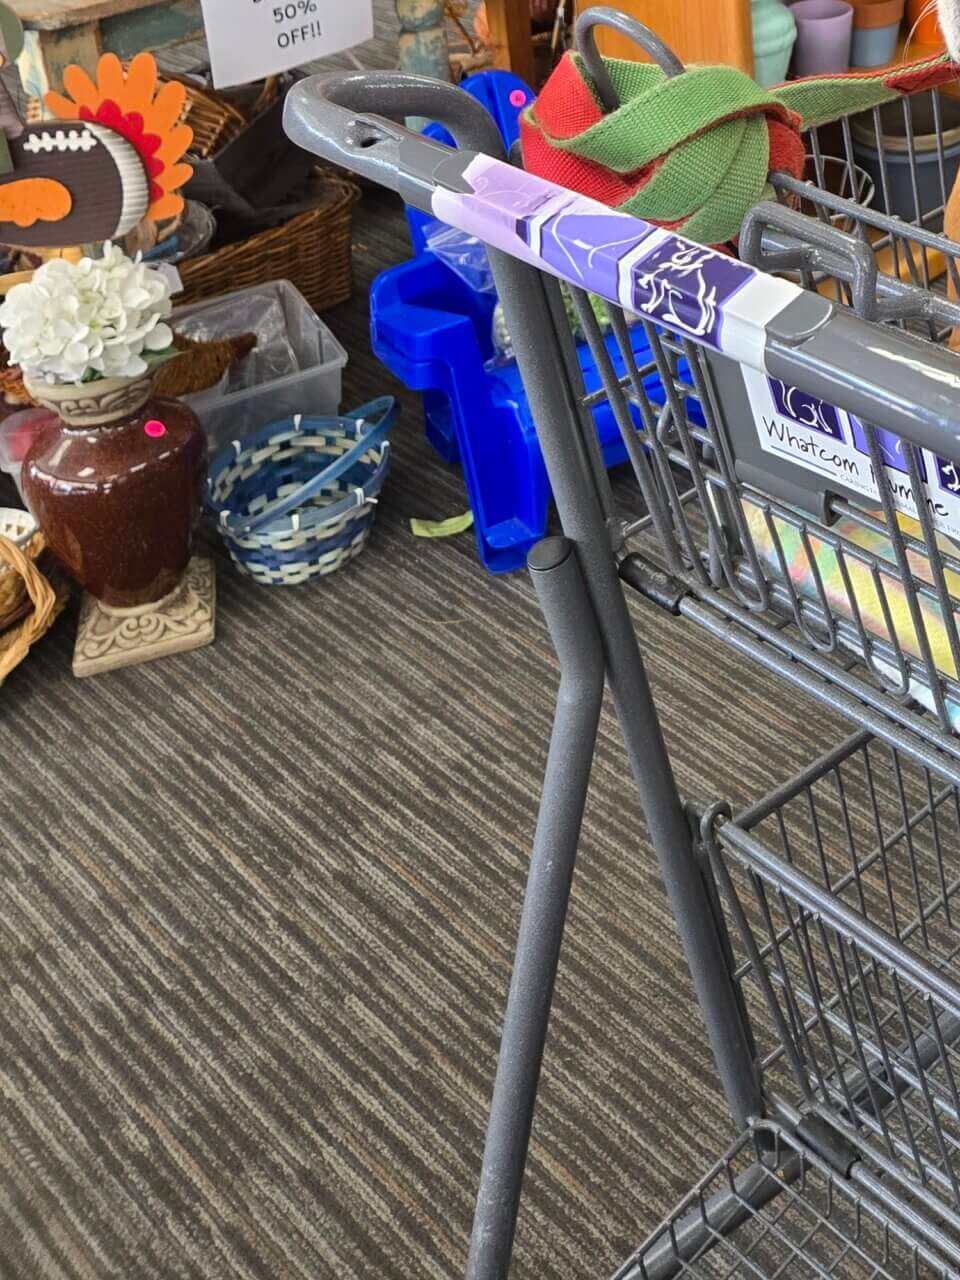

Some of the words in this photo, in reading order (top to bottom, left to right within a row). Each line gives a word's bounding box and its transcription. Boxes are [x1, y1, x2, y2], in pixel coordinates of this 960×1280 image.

[277, 20, 322, 48] OFF!!
[762, 415, 860, 476] Whatcom
[869, 463, 950, 517] umne
